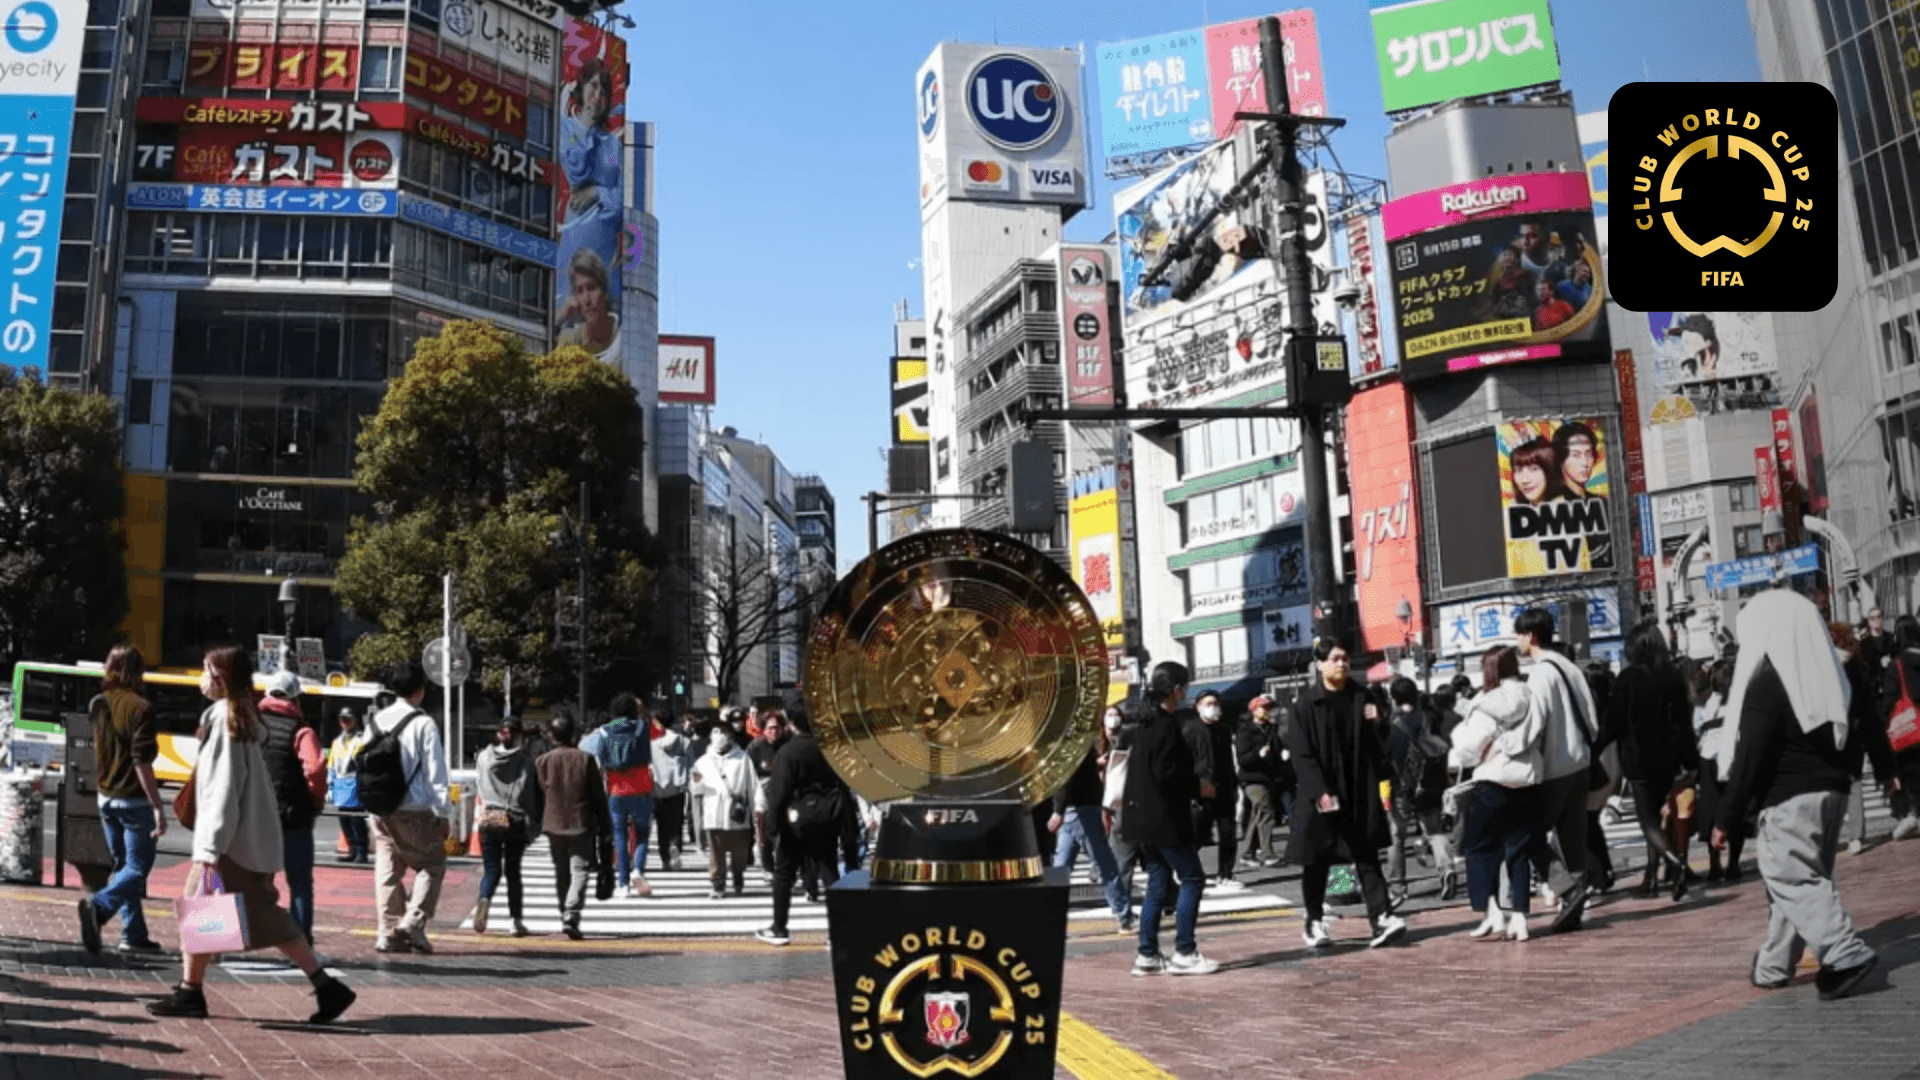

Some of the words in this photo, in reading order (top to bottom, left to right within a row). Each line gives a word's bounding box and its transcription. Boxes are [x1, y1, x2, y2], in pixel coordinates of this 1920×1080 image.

[190, 46, 348, 79] プライス
[1387, 13, 1544, 77] サロンパス
[405, 55, 521, 125] コンタクト
[1225, 66, 1311, 104] ダイト
[288, 101, 370, 131] ガスト
[137, 145, 175, 168] 7F
[231, 141, 334, 182] ガスト
[354, 157, 389, 170] ガスト
[491, 141, 545, 181] ガスト
[1031, 169, 1073, 186] VISA
[200, 187, 351, 210] 英会話イーオン
[1441, 185, 1527, 213] Rakuten
[2, 133, 55, 353] コンタクトの
[1360, 480, 1410, 581] クスリ
[1509, 500, 1607, 539] DMM
[1539, 537, 1582, 569] TV
[928, 809, 979, 824] FIFA
[850, 975, 876, 1051] CLUB
[875, 926, 986, 968] WORLD
[997, 947, 1041, 999] CUP
[1025, 1015, 1045, 1045] 25
